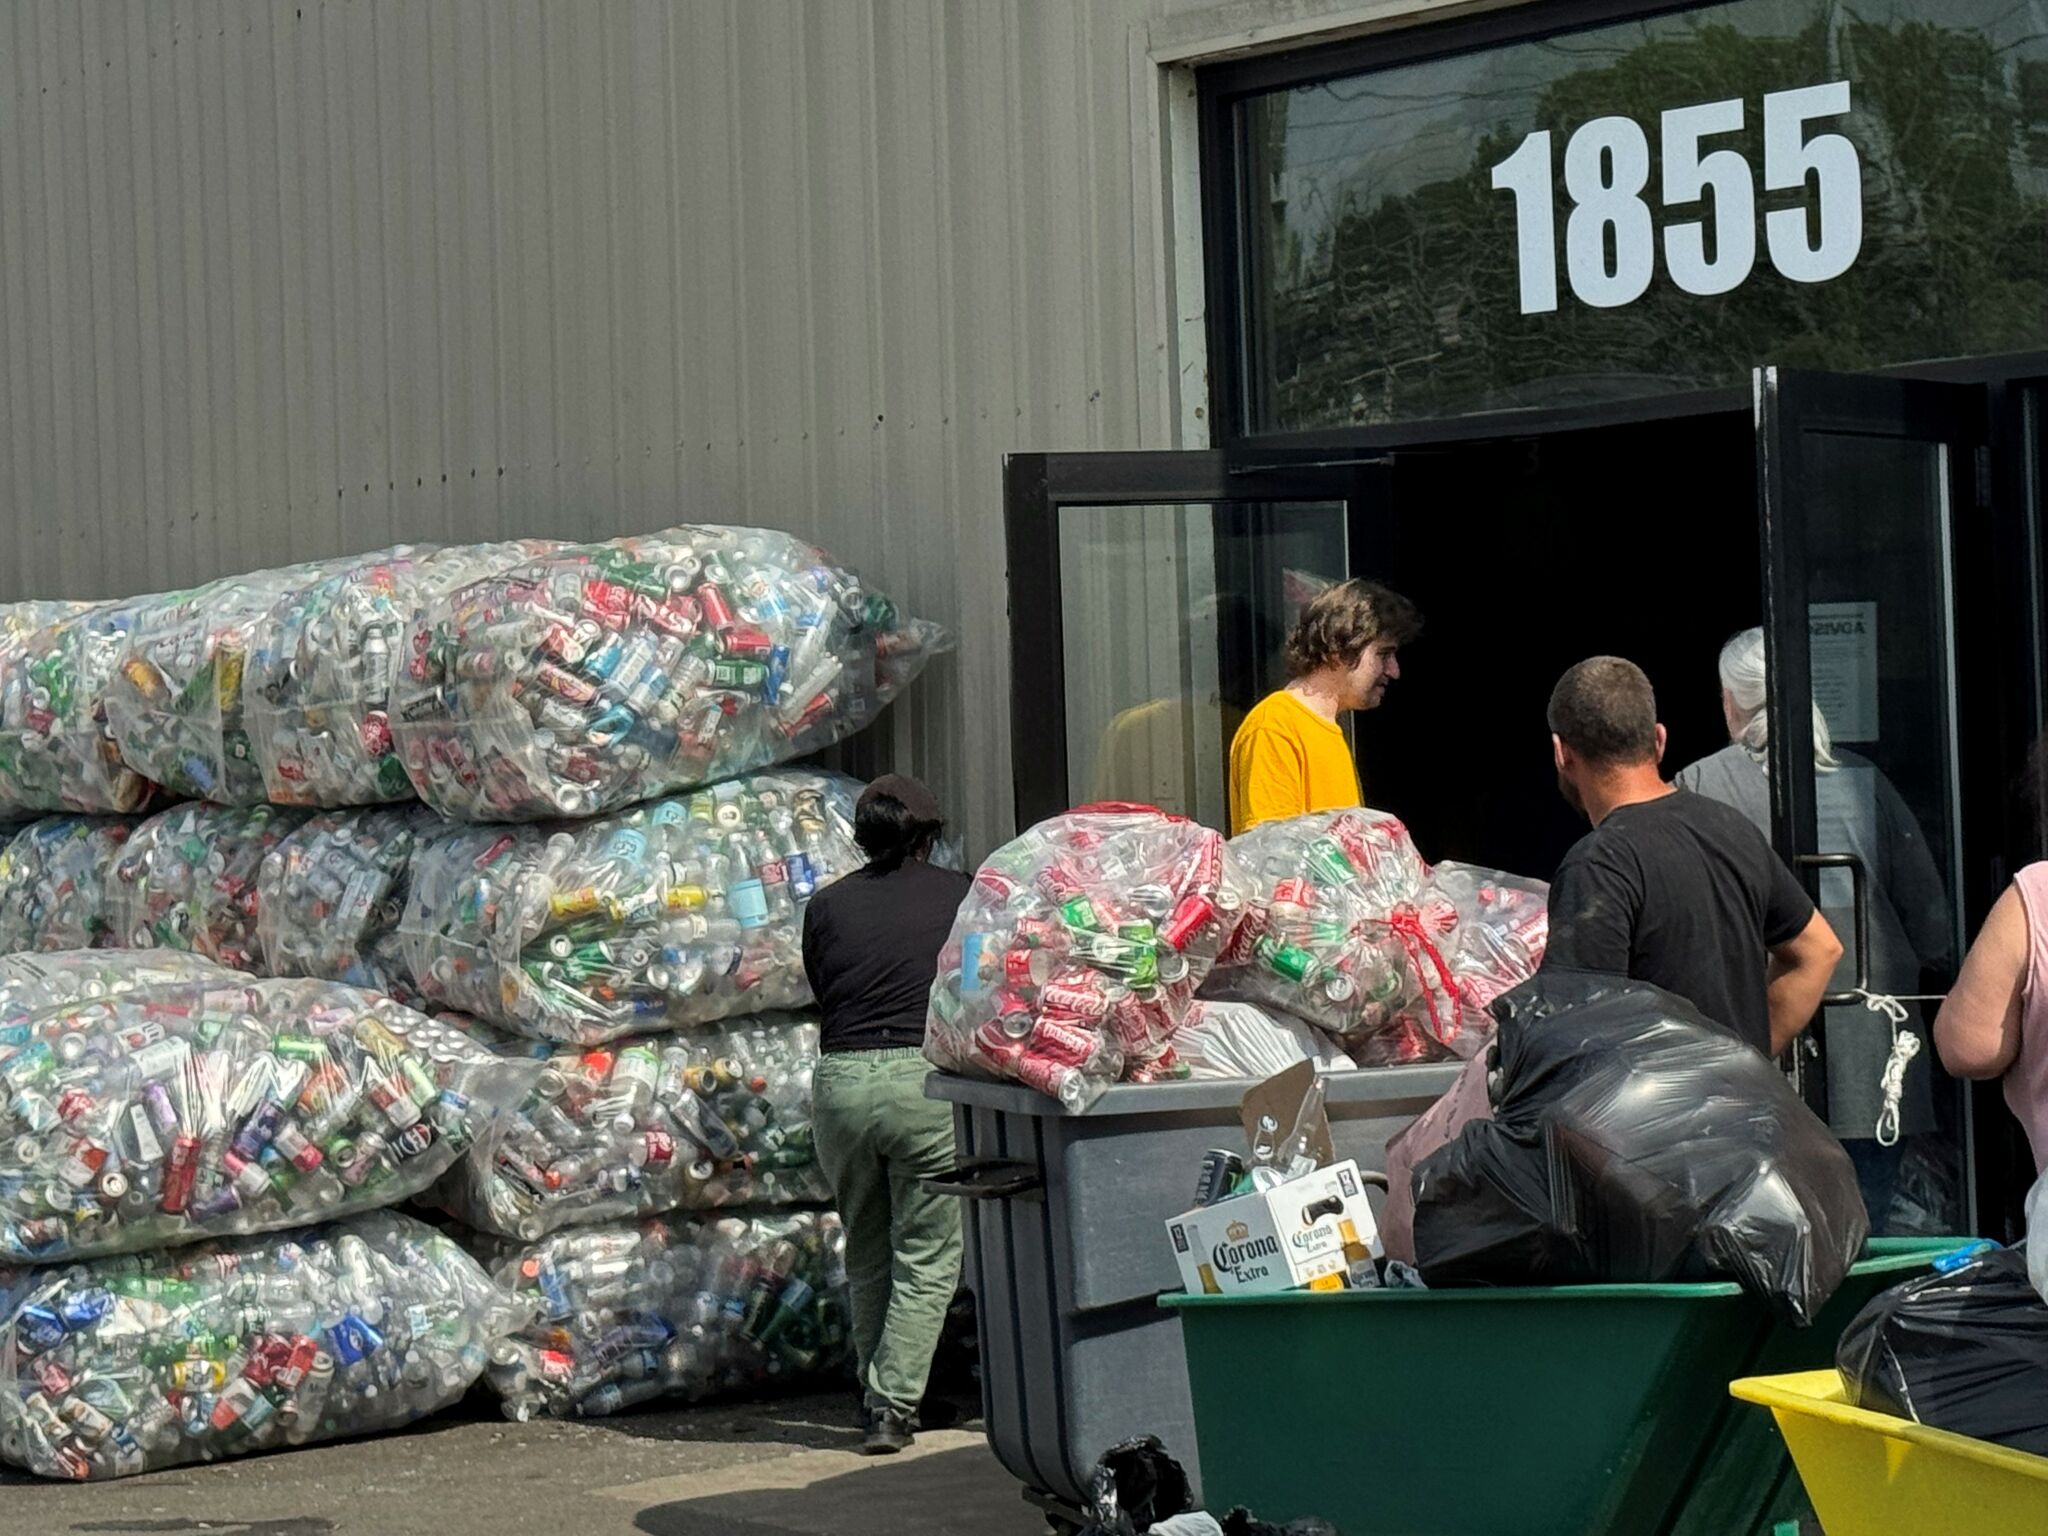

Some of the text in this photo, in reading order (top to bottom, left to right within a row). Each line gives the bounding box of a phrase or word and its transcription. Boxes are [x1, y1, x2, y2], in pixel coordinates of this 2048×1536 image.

[1491, 80, 1863, 315] 1855
[1292, 1224, 1333, 1248] Corona
[1213, 1235, 1279, 1273] Corona
[1232, 1265, 1269, 1284] Extra
